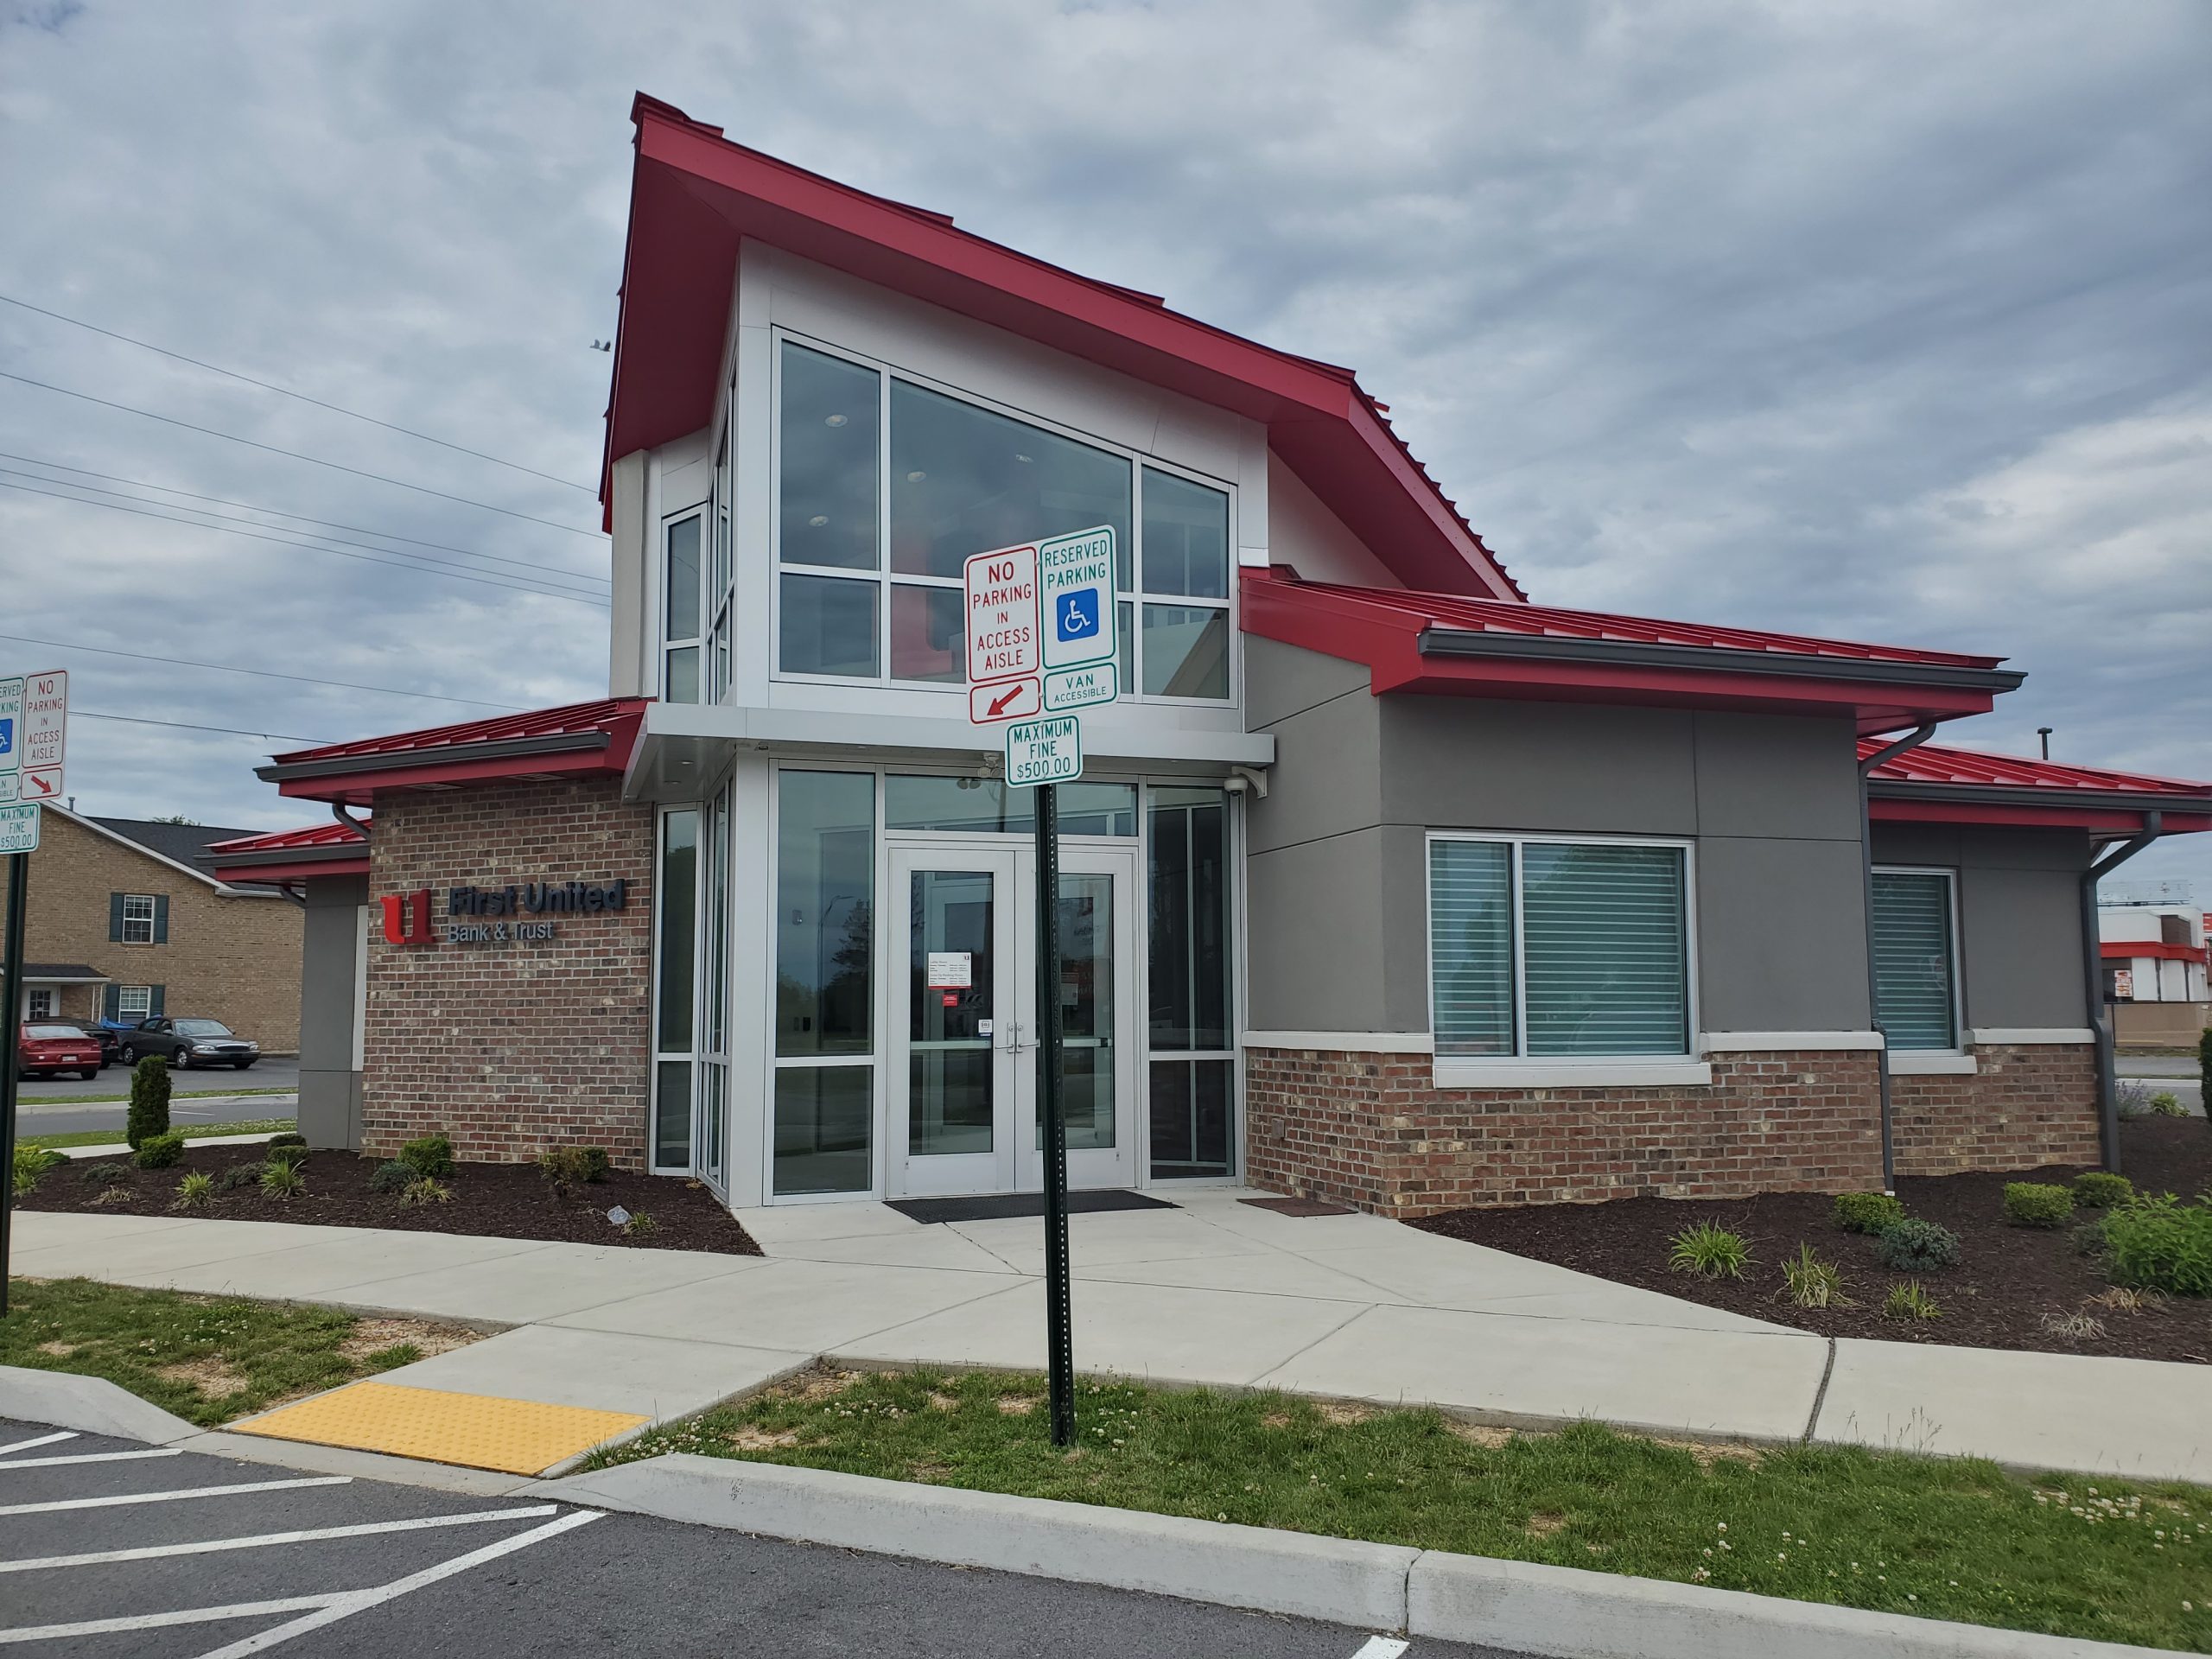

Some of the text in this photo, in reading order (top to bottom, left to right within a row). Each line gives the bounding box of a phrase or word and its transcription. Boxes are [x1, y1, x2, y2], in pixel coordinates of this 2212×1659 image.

[1045, 539, 1107, 569] RESERVED
[988, 561, 1014, 584] NO
[1047, 563, 1106, 589] PARKING
[973, 583, 1032, 609] PARKING
[997, 611, 1008, 625] IN
[977, 626, 1030, 652] ACCESS
[985, 649, 1023, 671] AISLE
[38, 680, 54, 696] NO
[1065, 673, 1094, 690] VAN
[1054, 686, 1107, 703] ACCESSIBLE
[0, 701, 19, 713] KING
[28, 698, 63, 714] PARKING
[41, 717, 48, 727] IN
[27, 730, 60, 746] ACCESS
[1014, 720, 1072, 744] MAXIMUM
[31, 747, 54, 760] AISLE
[1030, 741, 1057, 760] FINE
[1017, 757, 1071, 779] $500.00
[1, 807, 35, 821] MAXIMUM
[9, 822, 25, 834] FINE
[0, 834, 32, 848] $500.00
[449, 879, 626, 916] First United
[448, 921, 554, 944] Bank & Trust
